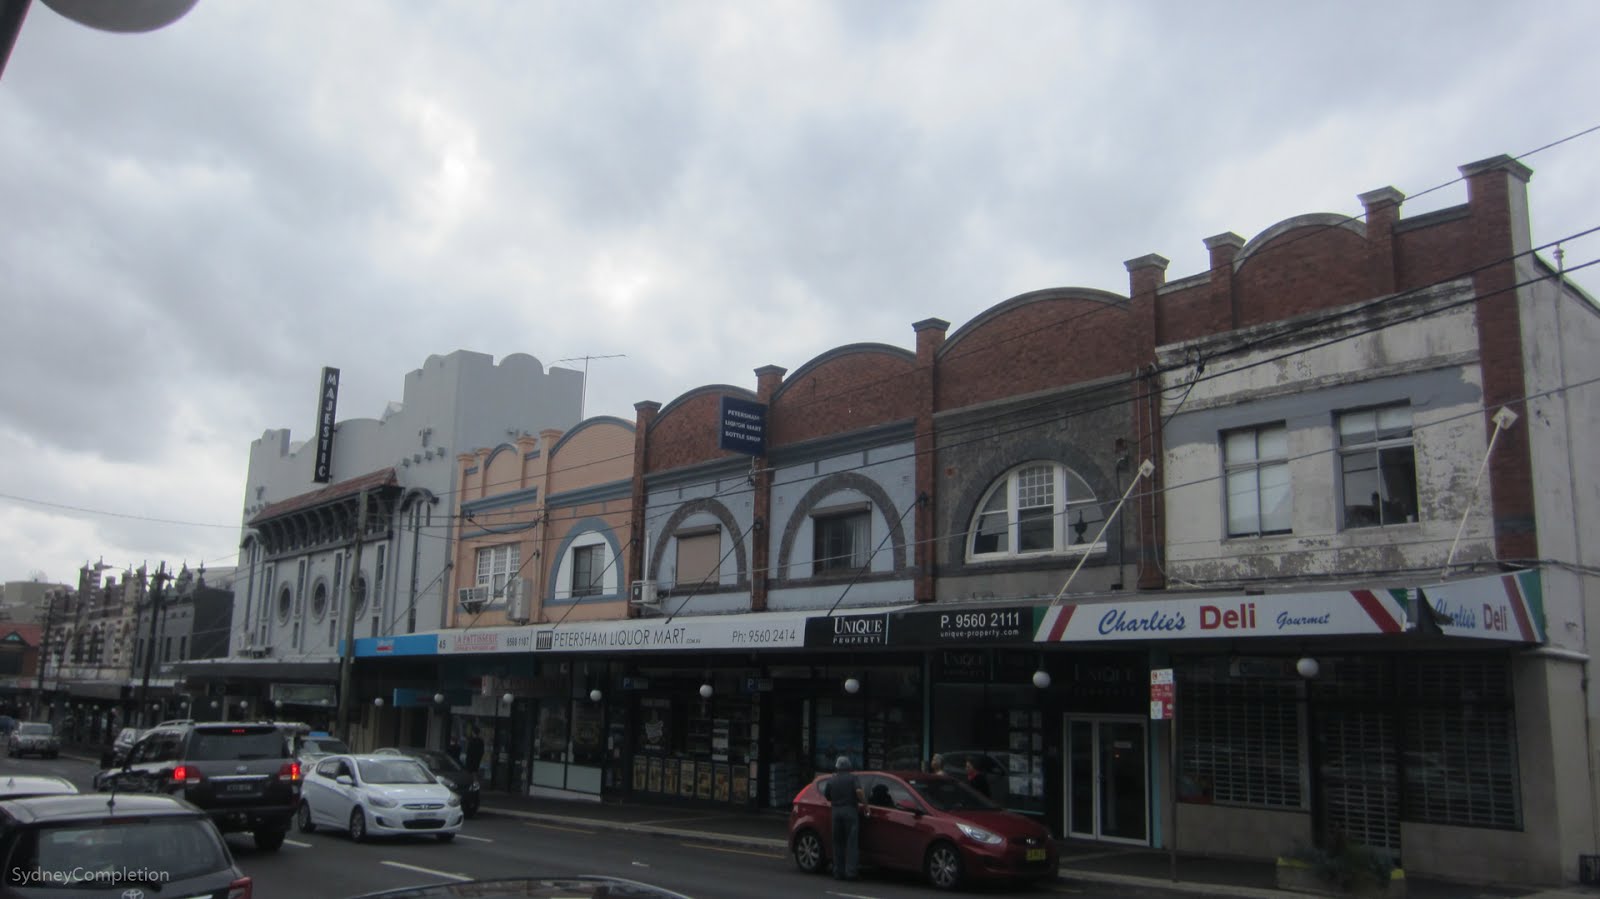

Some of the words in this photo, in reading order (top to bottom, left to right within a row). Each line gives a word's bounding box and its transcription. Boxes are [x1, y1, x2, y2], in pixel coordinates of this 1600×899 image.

[727, 409, 760, 420] PETERSHAM
[319, 373, 337, 477] MAJESTIC
[725, 430, 745, 440] BOTTLE
[746, 434, 761, 442] SHOP
[941, 615, 951, 628] P.
[955, 613, 986, 628] 9560
[990, 612, 1019, 627] 2111
[1098, 609, 1187, 635] Charlie's
[1200, 603, 1256, 630] Deli
[1276, 611, 1331, 629] Gourmet
[1435, 598, 1476, 629] Chrlie's
[1483, 603, 1508, 632] Deli
[554, 631, 607, 647] PETERSHAM
[610, 629, 650, 646] LIQUOR
[653, 628, 686, 645] MART
[732, 630, 747, 643] Ph:
[749, 630, 770, 643] 9560
[773, 629, 796, 642] 2414
[833, 636, 880, 644] PROPERTY
[940, 629, 1019, 639] unique-property.com
